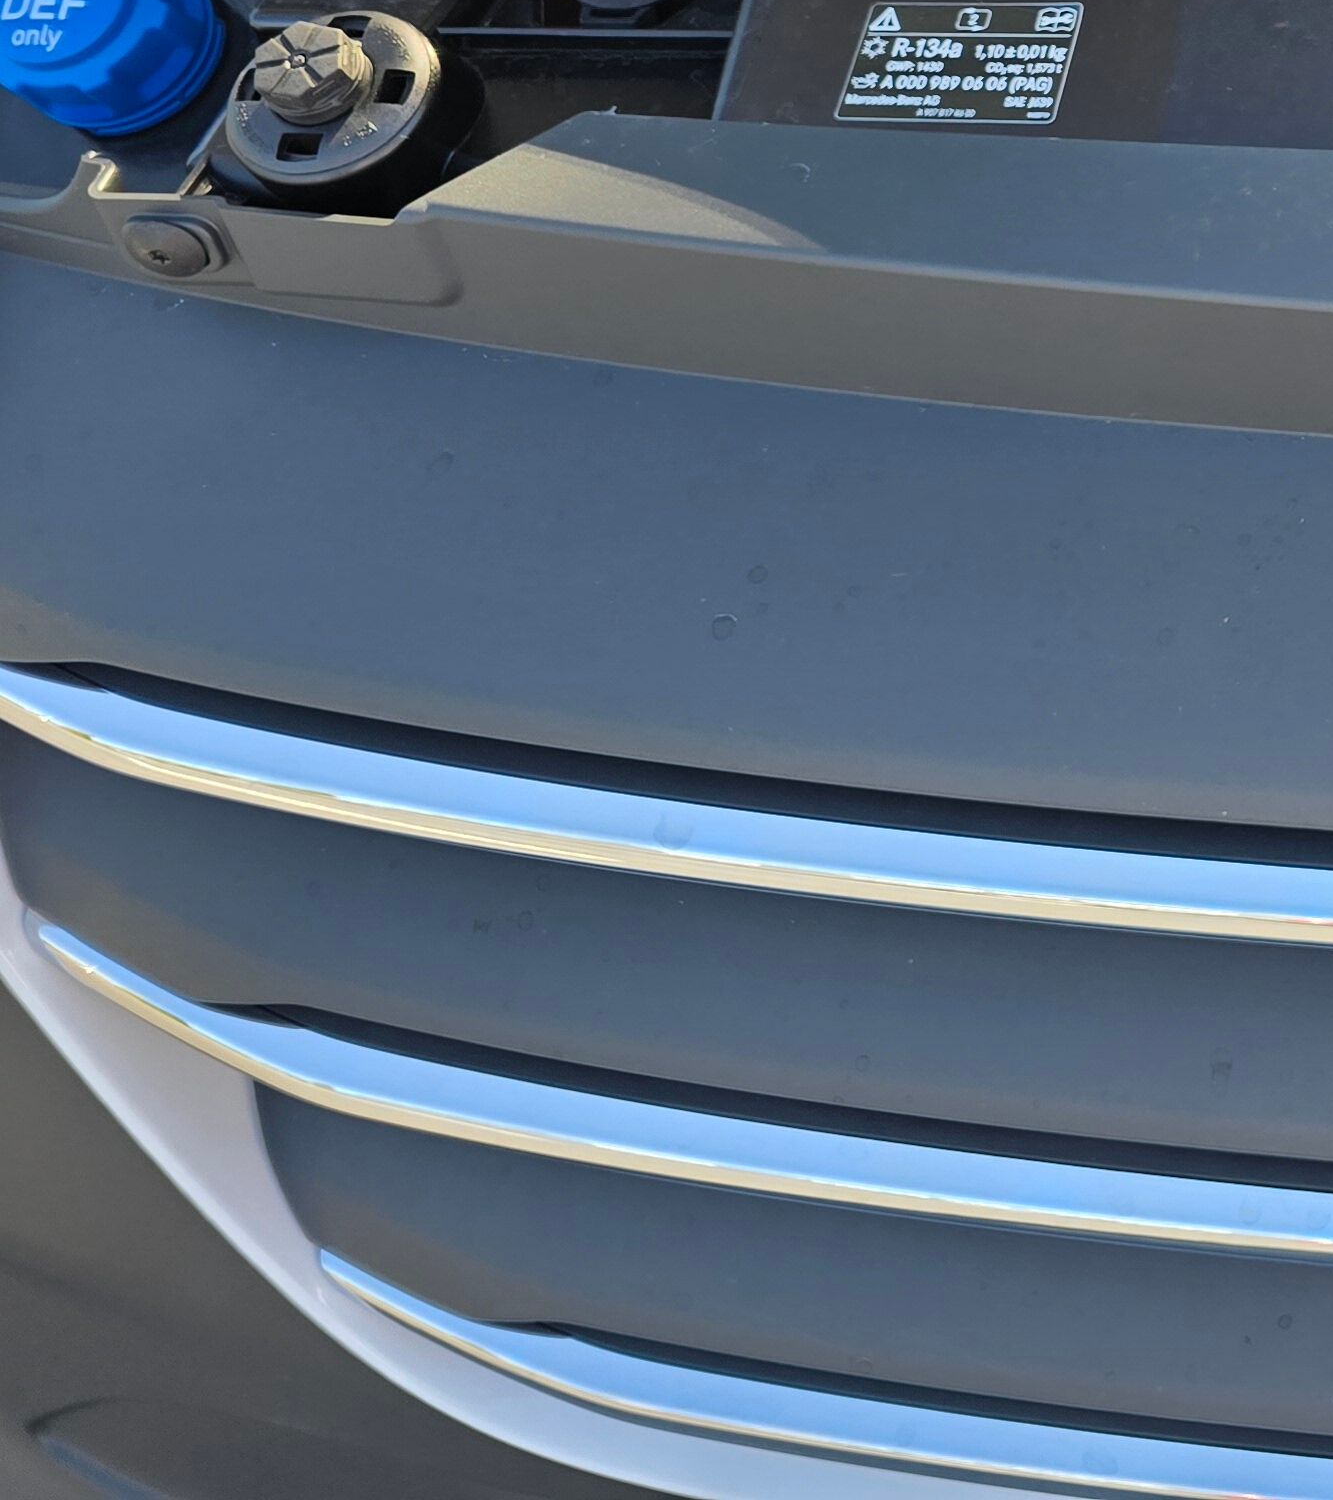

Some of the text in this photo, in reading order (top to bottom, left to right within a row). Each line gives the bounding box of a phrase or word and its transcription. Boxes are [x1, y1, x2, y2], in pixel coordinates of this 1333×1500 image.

[11, 24, 64, 52] only
[890, 37, 964, 59] R-134a
[879, 75, 894, 90] A
[894, 76, 929, 91] 000
[1008, 76, 1054, 95] (PAG)
[844, 93, 924, 106] Mercedes-Benz
[922, 94, 942, 107] AG
[1003, 96, 1028, 108] SAE
